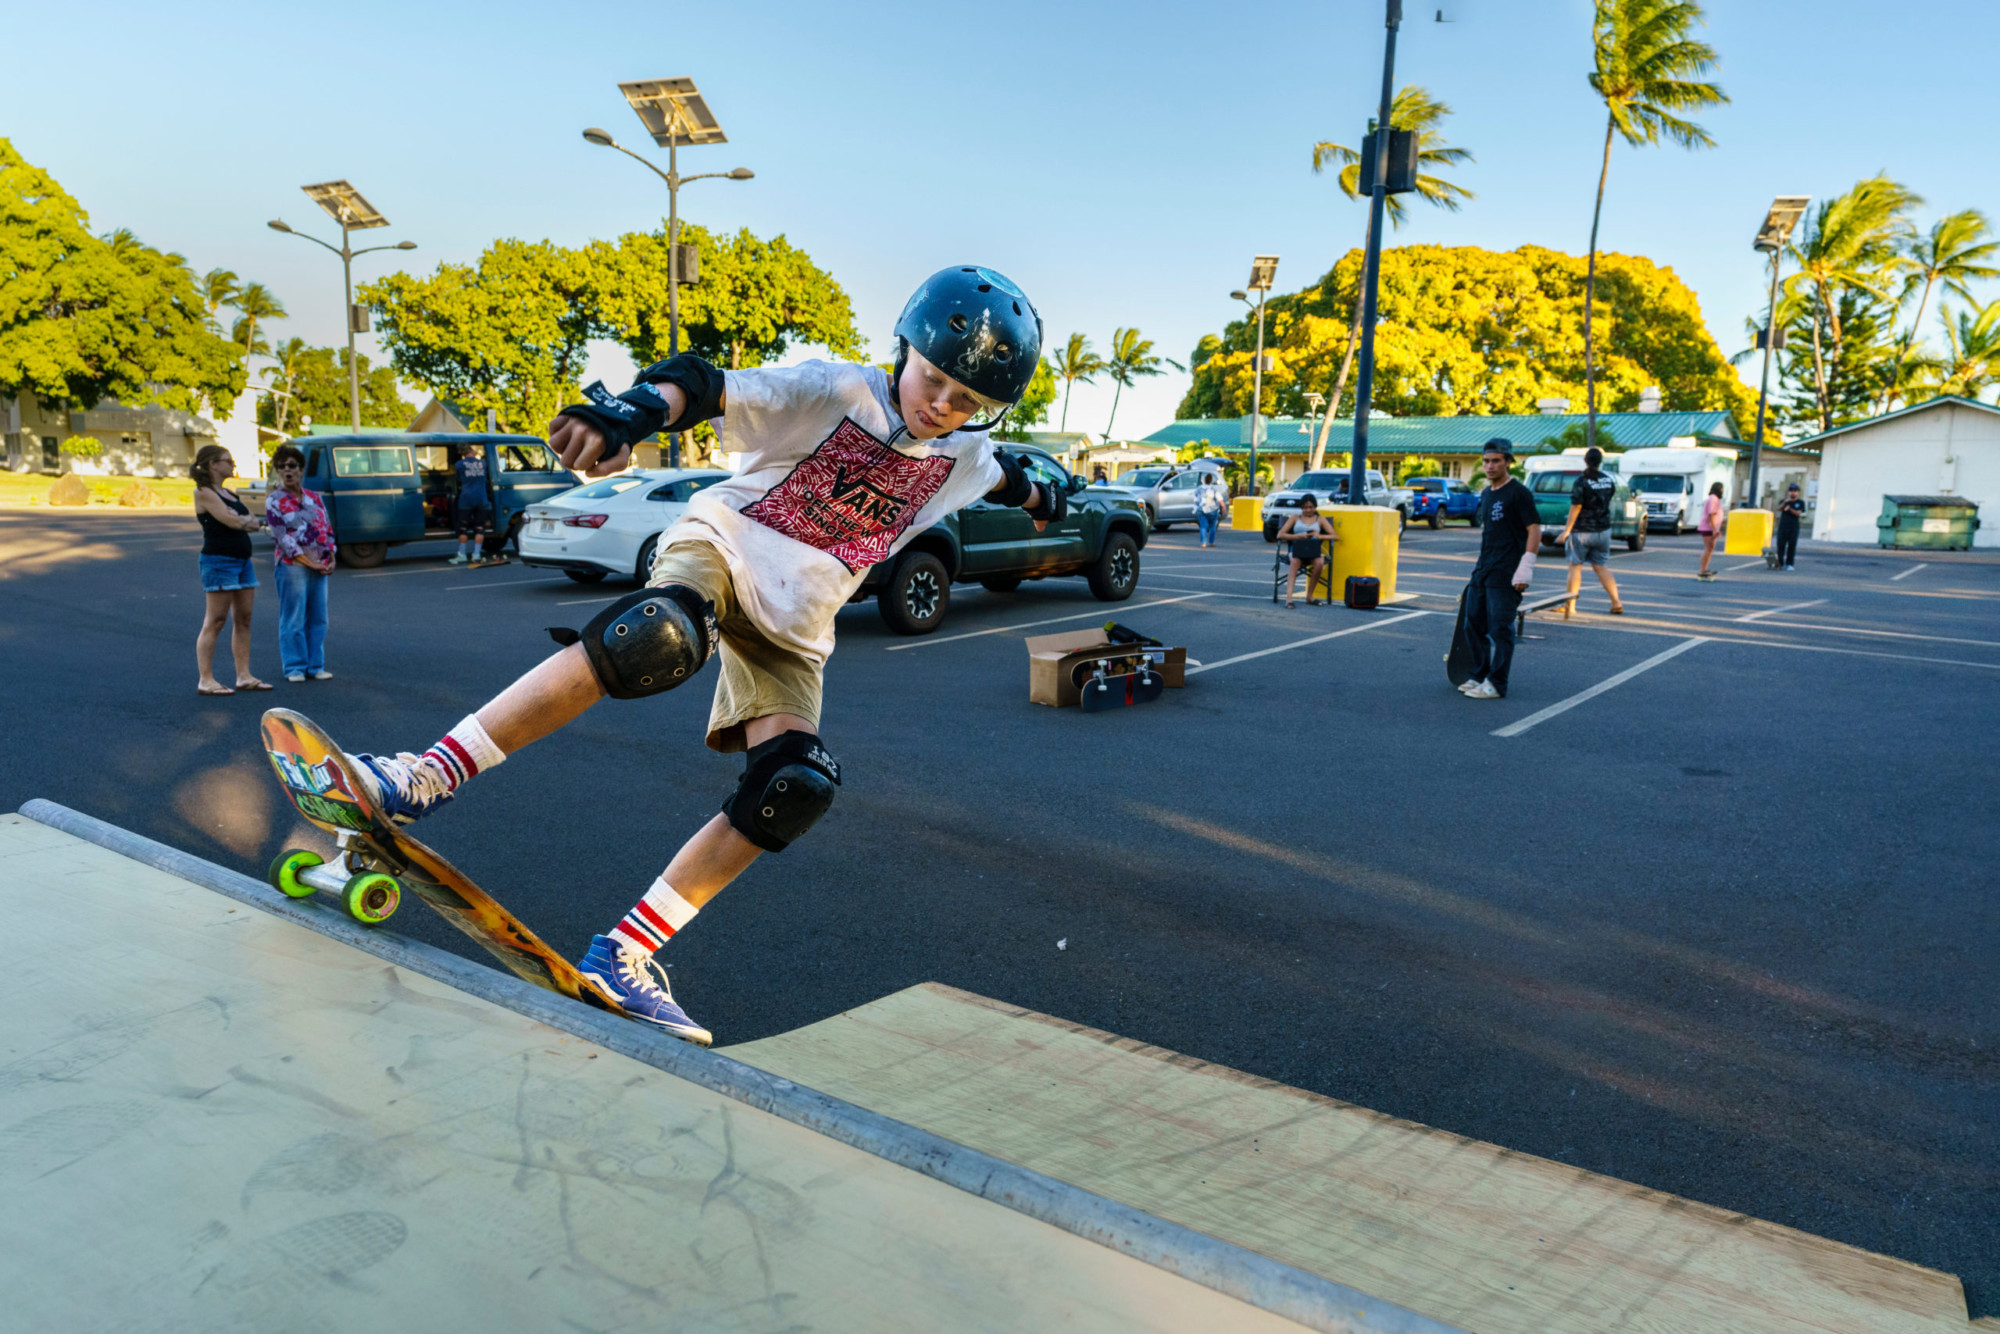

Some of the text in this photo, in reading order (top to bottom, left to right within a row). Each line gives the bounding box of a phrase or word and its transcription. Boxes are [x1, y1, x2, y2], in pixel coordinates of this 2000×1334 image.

[831, 465, 909, 526] VANS
[804, 506, 845, 541] SINCE
[833, 512, 860, 532] THE
